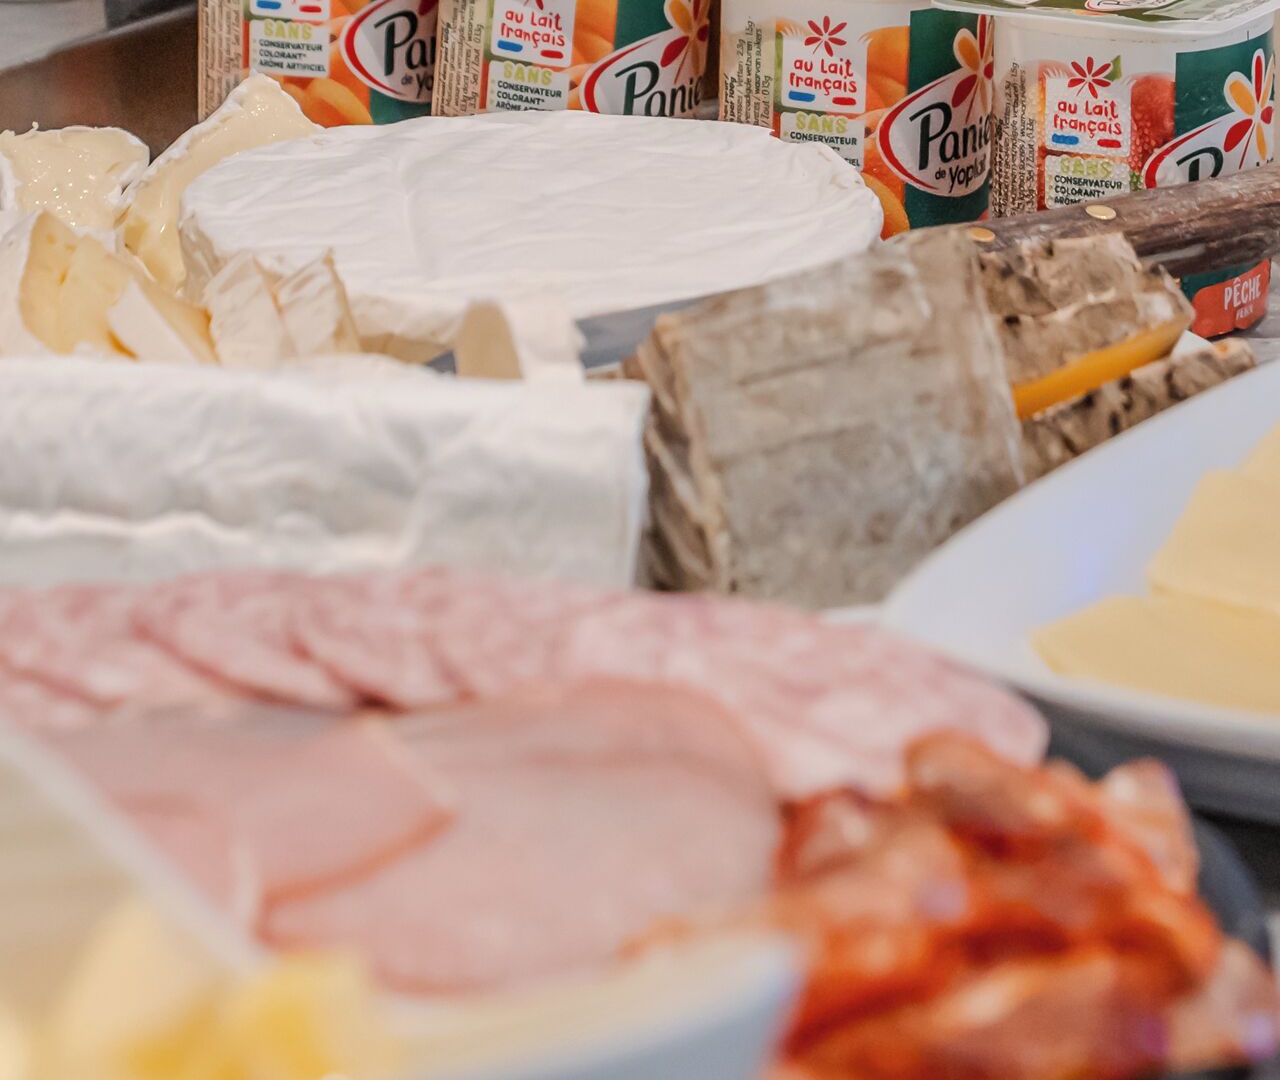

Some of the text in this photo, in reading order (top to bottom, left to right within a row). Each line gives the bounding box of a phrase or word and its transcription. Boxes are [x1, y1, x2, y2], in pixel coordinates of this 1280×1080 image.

[506, 10, 524, 24] au
[264, 21, 313, 41] SANS
[500, 23, 566, 48] français
[259, 39, 323, 52] CONSERVATEUR
[503, 63, 553, 86] SANS
[794, 59, 813, 72] au
[497, 80, 563, 99] CONSERVATEUR
[789, 73, 858, 95] français
[1058, 100, 1077, 114] au
[796, 113, 848, 134] SANS
[1053, 116, 1122, 138] français
[790, 131, 857, 146] CONSERVATEUR
[909, 102, 993, 171] Panie
[935, 170, 946, 181] de
[1060, 158, 1112, 178] SANS
[1054, 175, 1122, 190] CONSERVATEUR
[1224, 274, 1261, 311] PÊCHE
